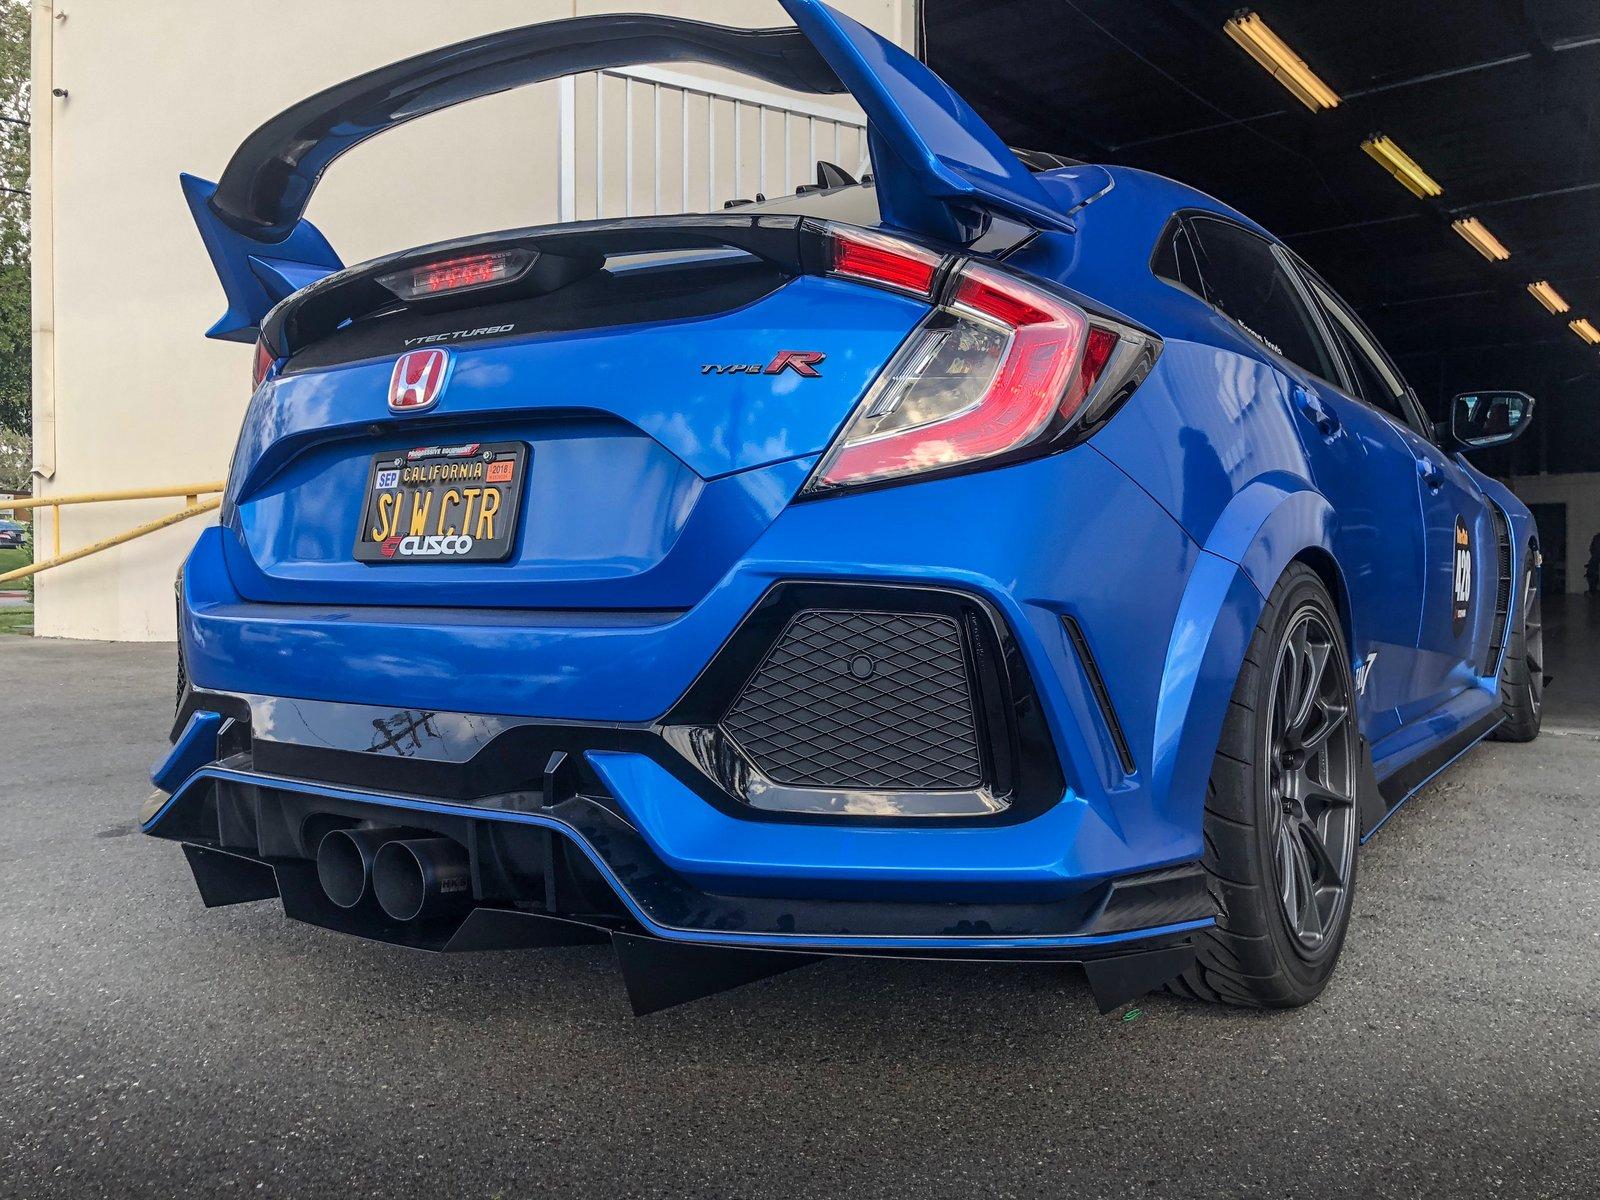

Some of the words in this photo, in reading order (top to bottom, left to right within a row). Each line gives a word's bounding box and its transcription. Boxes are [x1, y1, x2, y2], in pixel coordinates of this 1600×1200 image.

[404, 332, 450, 346] VTEC
[450, 323, 515, 339] TURBO
[701, 363, 762, 376] TYPE
[763, 350, 827, 377] R
[379, 472, 397, 487] SEP
[403, 462, 482, 482] CALIFORNIA
[399, 535, 473, 555] CUSCO
